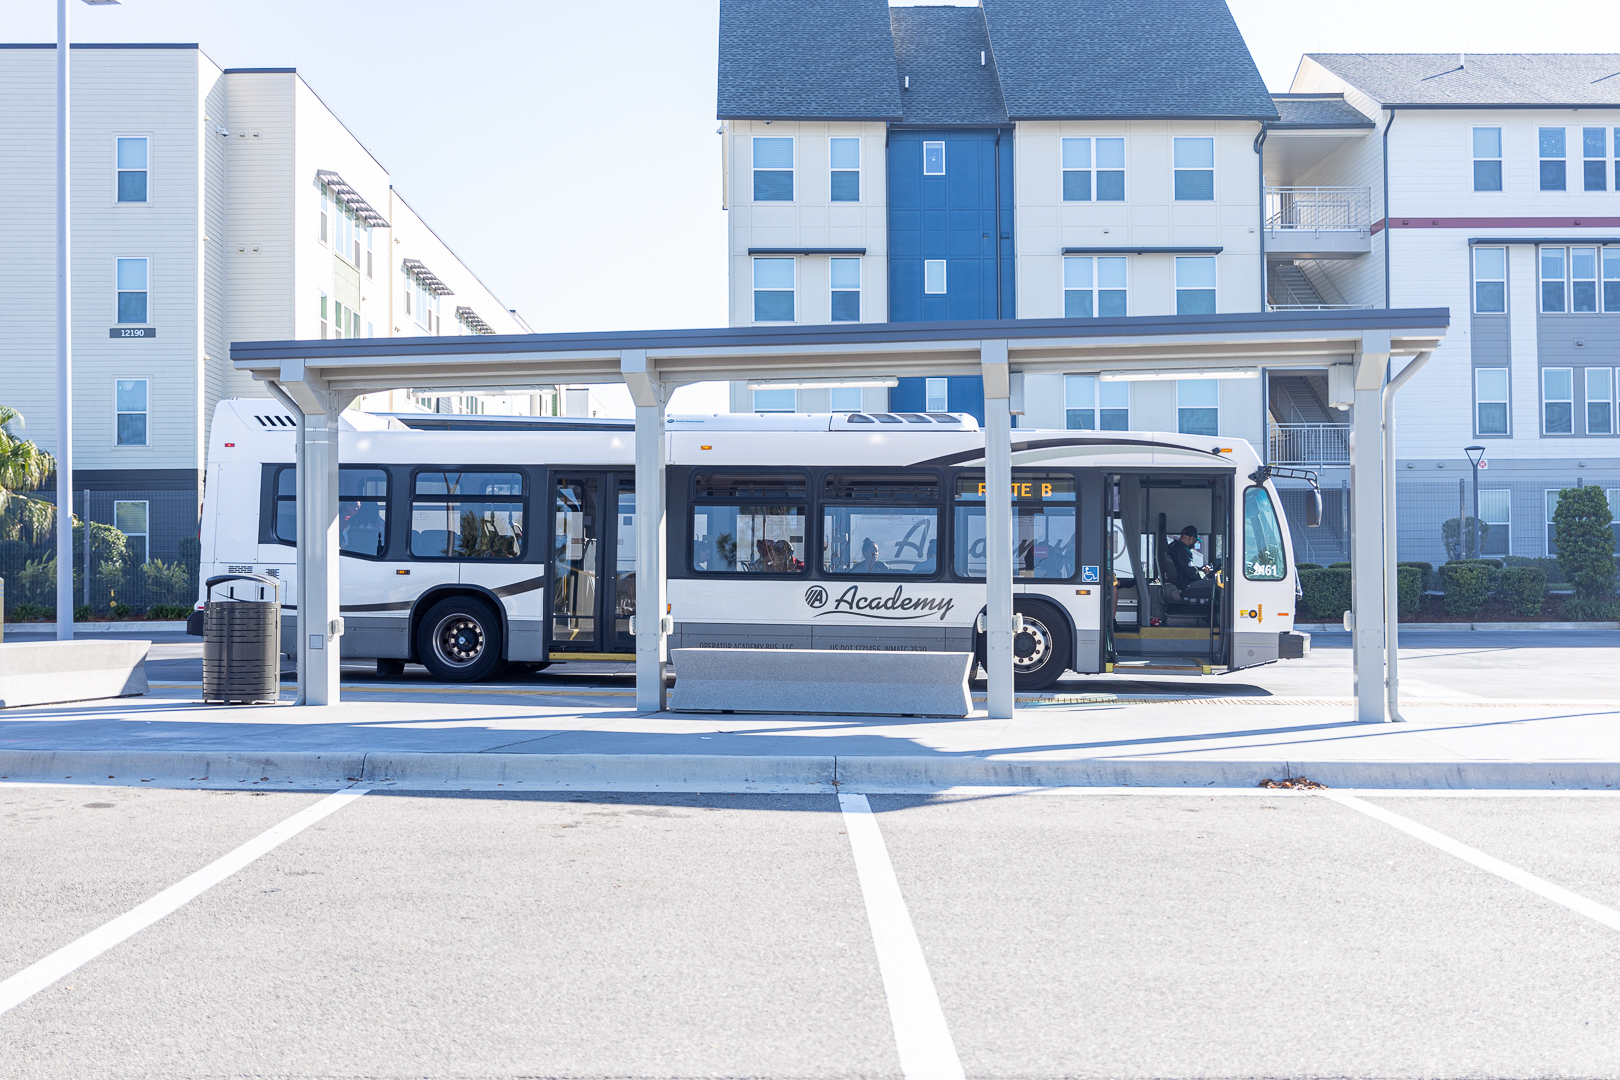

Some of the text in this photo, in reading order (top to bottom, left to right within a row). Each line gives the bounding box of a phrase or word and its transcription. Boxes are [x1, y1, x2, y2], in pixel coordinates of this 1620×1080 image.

[121, 329, 145, 337] 12190
[978, 482, 1053, 498] RTE B
[834, 584, 954, 620] Academy
